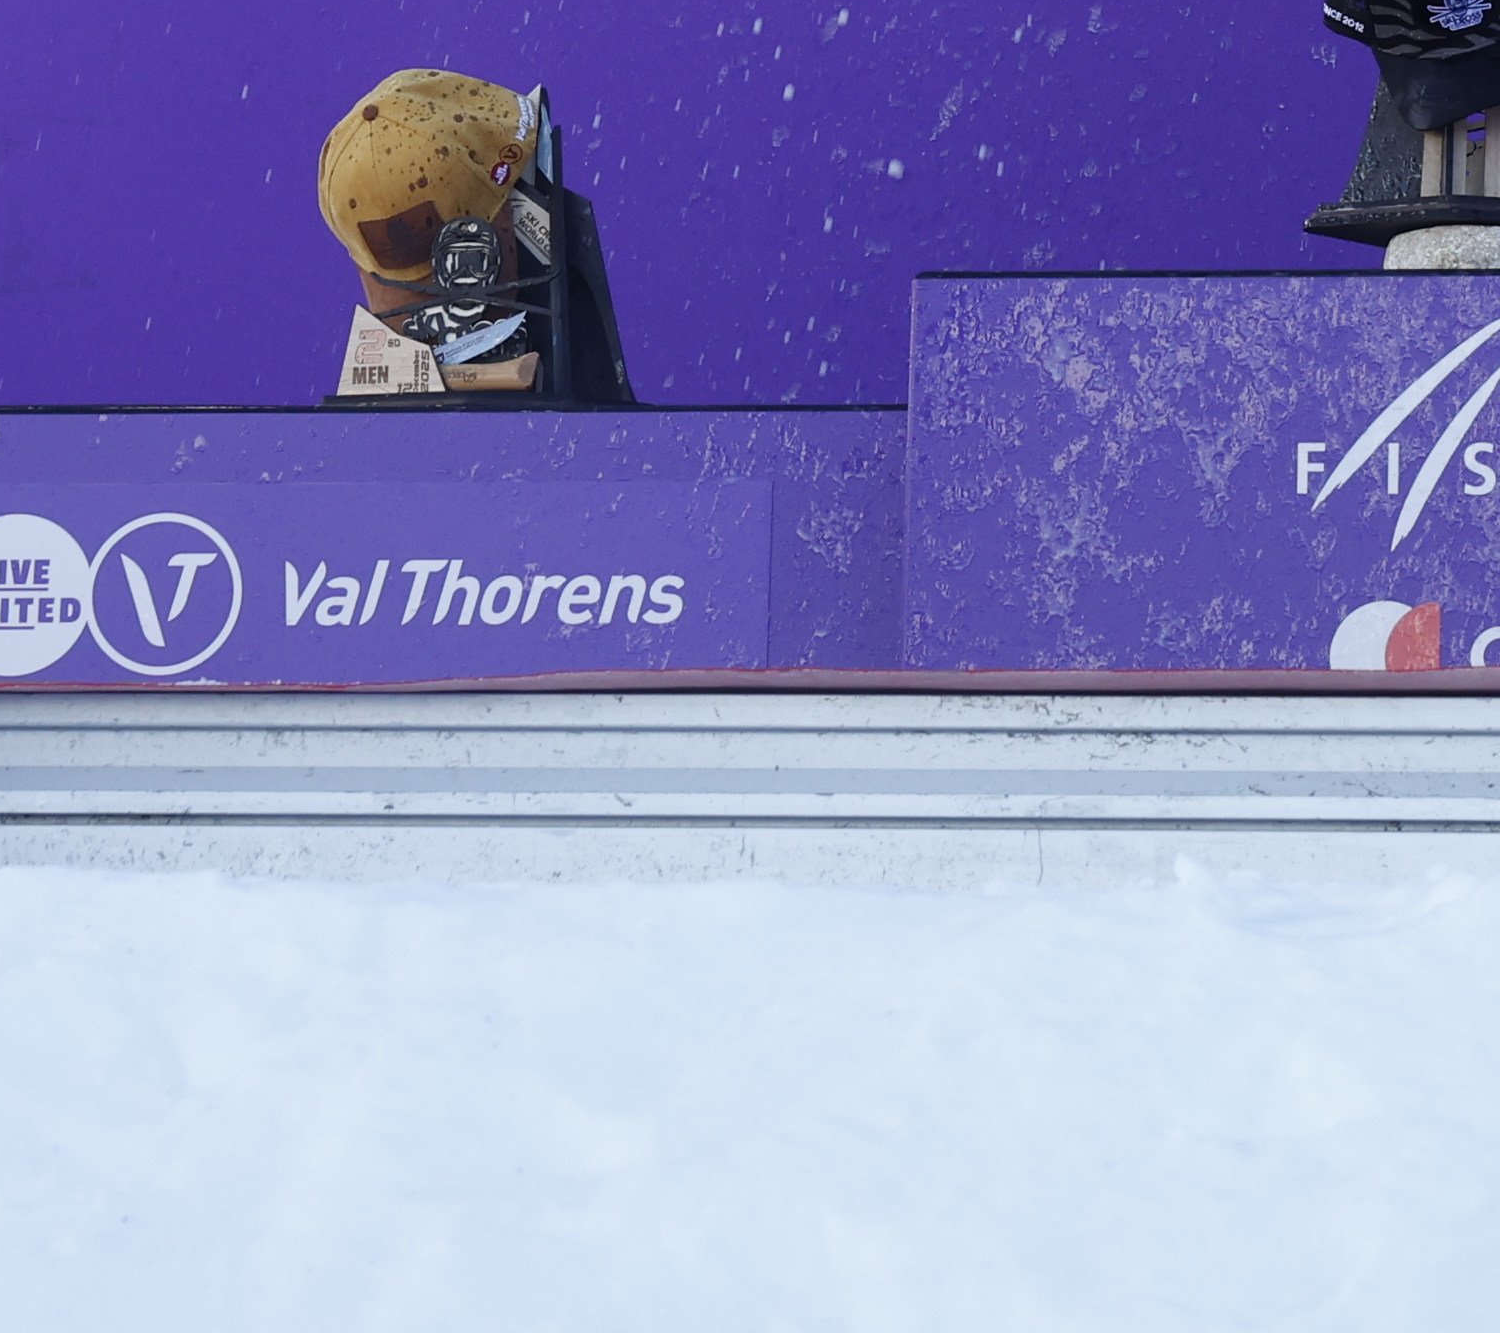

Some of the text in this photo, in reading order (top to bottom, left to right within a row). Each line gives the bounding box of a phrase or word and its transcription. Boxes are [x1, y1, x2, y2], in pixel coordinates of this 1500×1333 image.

[351, 365, 390, 386] MEN
[284, 558, 684, 627] Val Thorens
